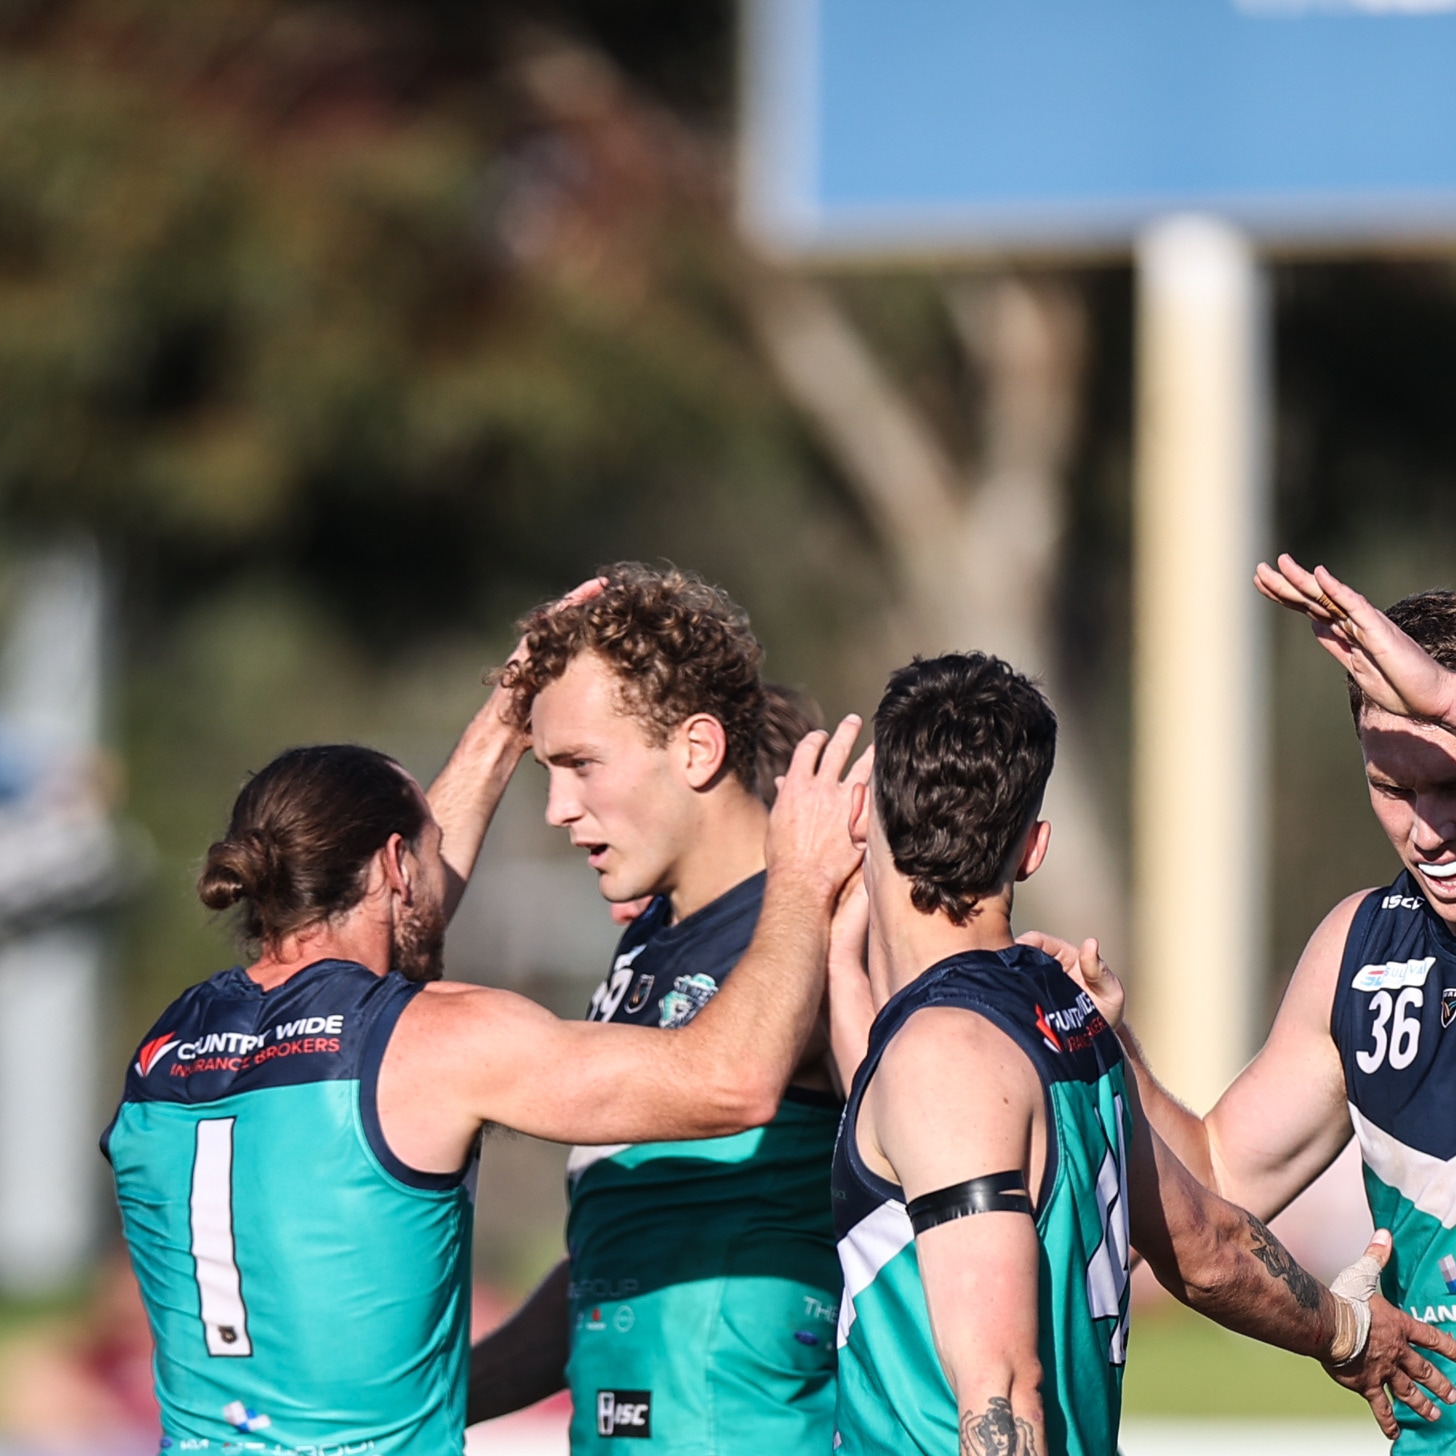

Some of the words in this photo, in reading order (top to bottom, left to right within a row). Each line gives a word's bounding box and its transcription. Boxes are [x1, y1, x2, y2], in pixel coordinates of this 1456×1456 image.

[275, 1014, 344, 1040] WIDE
[1355, 987, 1424, 1074] 36
[189, 1115, 253, 1357] 1
